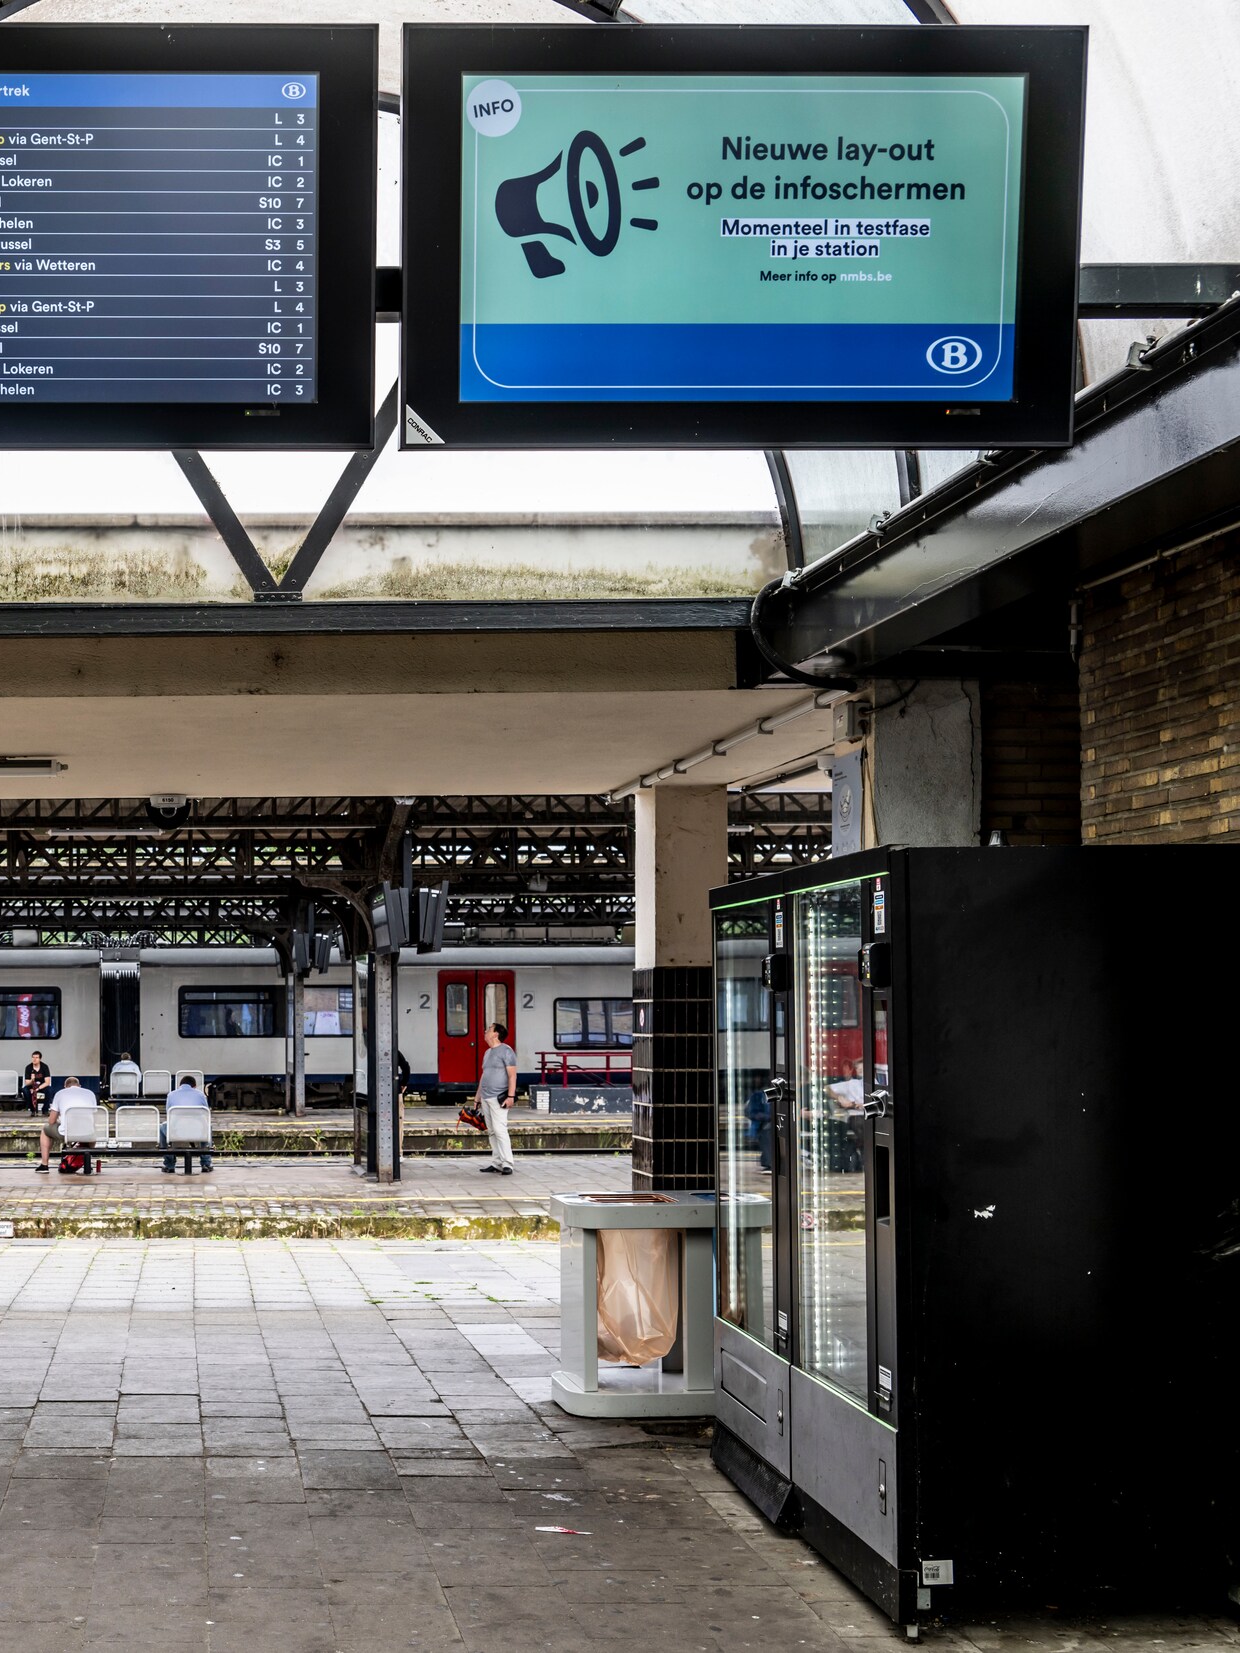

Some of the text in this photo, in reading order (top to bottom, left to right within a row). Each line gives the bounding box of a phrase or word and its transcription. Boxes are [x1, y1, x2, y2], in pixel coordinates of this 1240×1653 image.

[473, 99, 513, 118] INFO
[275, 113, 282, 124] L
[297, 114, 304, 124] 3
[9, 133, 26, 144] via
[31, 133, 93, 144] Gent-St-P
[275, 134, 282, 145] L
[297, 135, 305, 145] 4
[722, 136, 935, 166] Nieuwe lay-out
[269, 155, 282, 166] IC
[299, 156, 303, 166] 1
[2, 175, 52, 186] Lokeren
[268, 176, 282, 187] IC
[297, 177, 304, 187] 2
[687, 176, 965, 205] op de infoschermen
[259, 197, 282, 209] S10
[297, 198, 304, 208] 7
[268, 218, 281, 229] IC
[297, 219, 304, 229] 3
[722, 220, 929, 235] Momenteel in testfase
[265, 238, 282, 251] S3
[297, 240, 304, 250] 5
[771, 240, 879, 259] in je station
[15, 259, 32, 270] via
[36, 260, 95, 270] Wetteren
[267, 259, 282, 271] IC
[296, 261, 304, 271] 4
[760, 271, 892, 284] Meer info op nmbs.be
[275, 281, 281, 291] L
[296, 282, 303, 292] 3
[10, 301, 28, 312] via
[32, 301, 94, 312] Gent-St-P
[275, 302, 281, 312] L
[296, 303, 304, 312] 4
[268, 322, 281, 333] IC
[298, 323, 302, 333] 1
[259, 343, 280, 354] S10
[296, 344, 303, 353] 7
[4, 363, 53, 374] Lokeren
[268, 364, 281, 374] IC
[296, 364, 303, 374] 2
[268, 384, 281, 395] IC
[296, 385, 303, 395] 3
[408, 418, 432, 443] CONRAC
[419, 994, 431, 1009] 2
[523, 993, 534, 1009] 2
